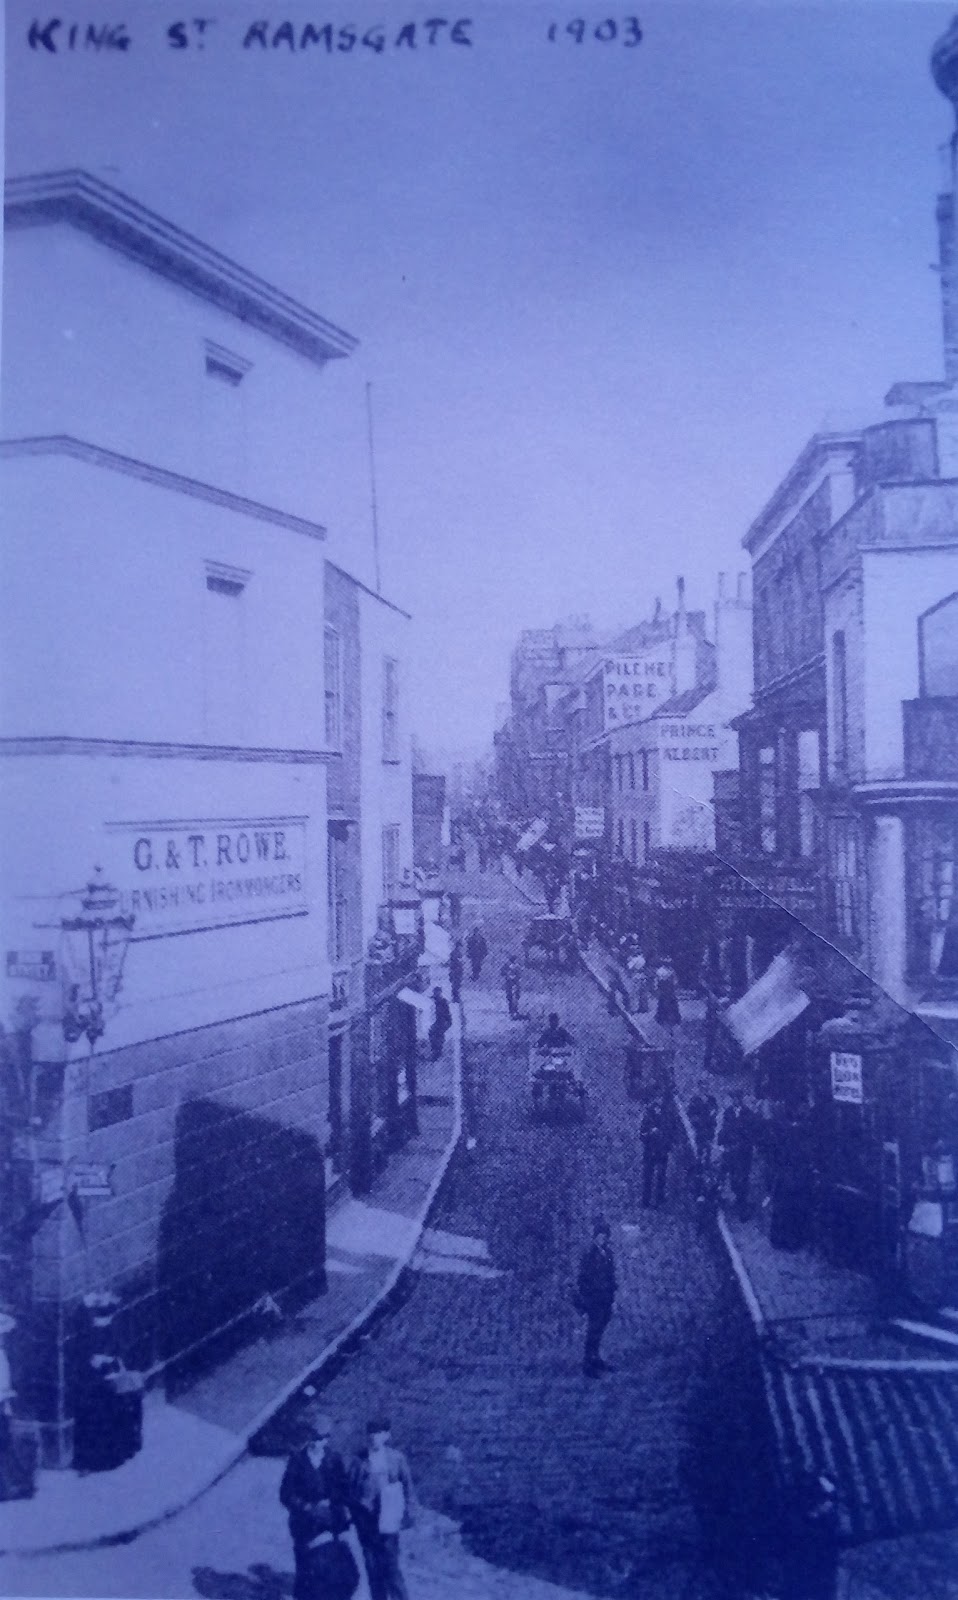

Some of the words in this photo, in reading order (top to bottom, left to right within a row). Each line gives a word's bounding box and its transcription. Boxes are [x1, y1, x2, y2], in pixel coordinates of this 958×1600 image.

[27, 17, 132, 54] KING
[243, 18, 474, 54] RAMSGATE
[548, 17, 645, 46] 1903
[660, 724, 716, 738] PRINCE
[165, 840, 181, 870] &
